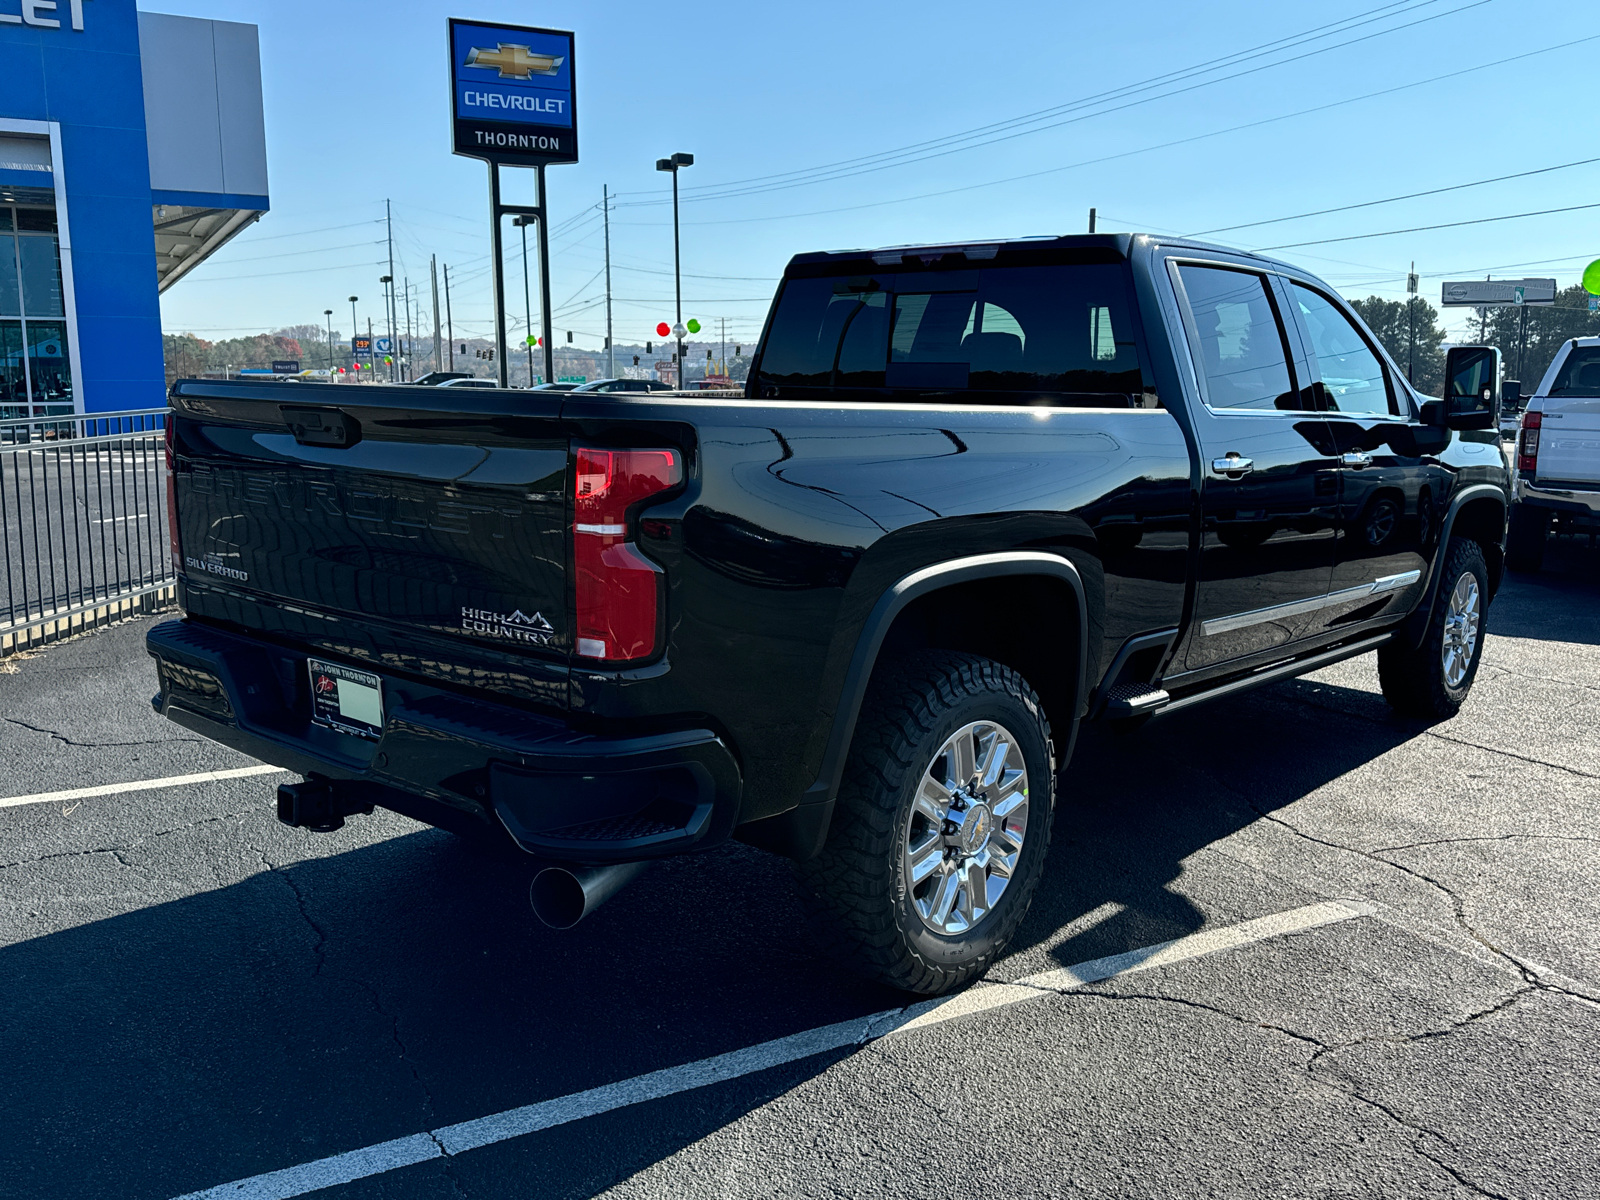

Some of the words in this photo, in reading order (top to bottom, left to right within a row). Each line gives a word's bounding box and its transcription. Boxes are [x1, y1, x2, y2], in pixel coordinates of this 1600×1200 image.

[464, 91, 565, 113] CHEVROLET
[475, 131, 560, 150] THORNTON
[191, 463, 522, 539] CHEVROLET
[186, 556, 249, 582] SILVERADO
[461, 606, 506, 623] HIGH
[462, 618, 554, 645] COUNTRY
[324, 664, 340, 676] JOHN
[341, 669, 377, 686] THORNTON
